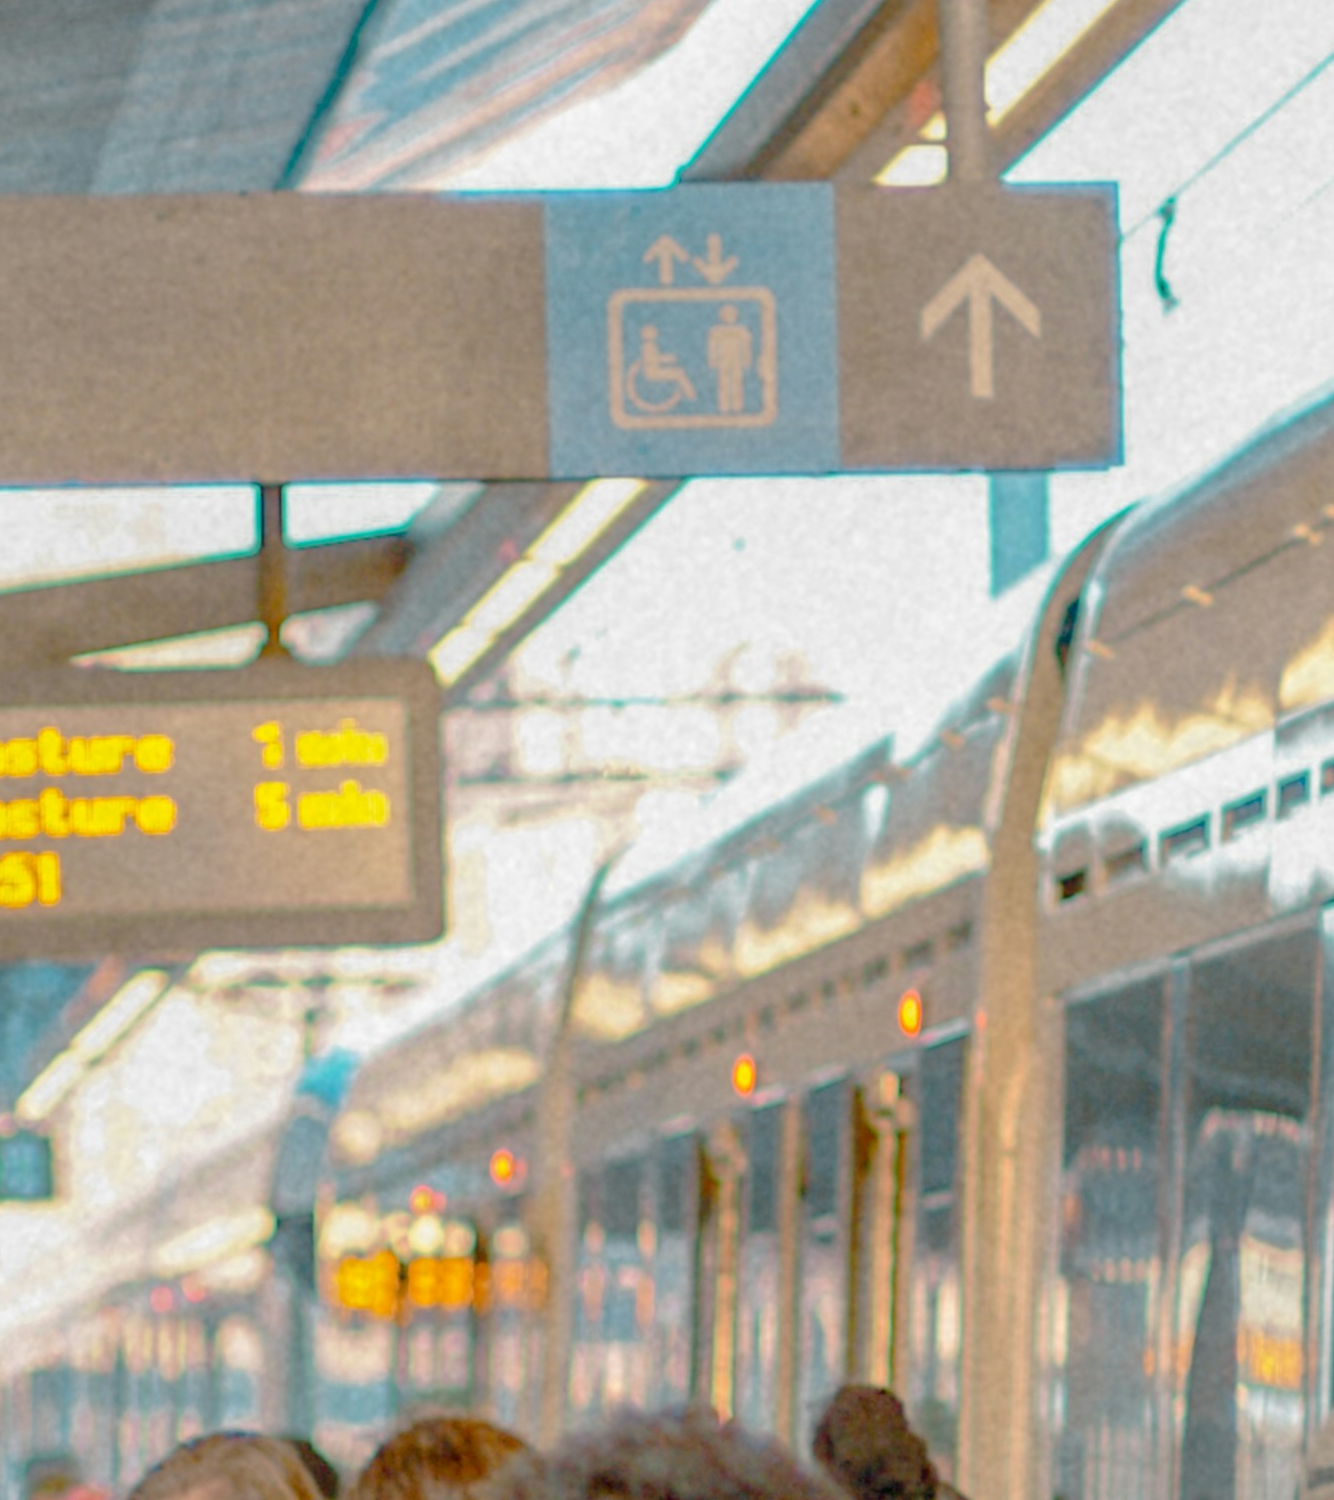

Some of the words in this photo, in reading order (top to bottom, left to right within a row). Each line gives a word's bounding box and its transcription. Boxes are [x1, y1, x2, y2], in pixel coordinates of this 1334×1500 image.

[253, 721, 284, 769] 1
[295, 717, 388, 769] min
[254, 781, 291, 831] 5
[297, 779, 389, 831] min
